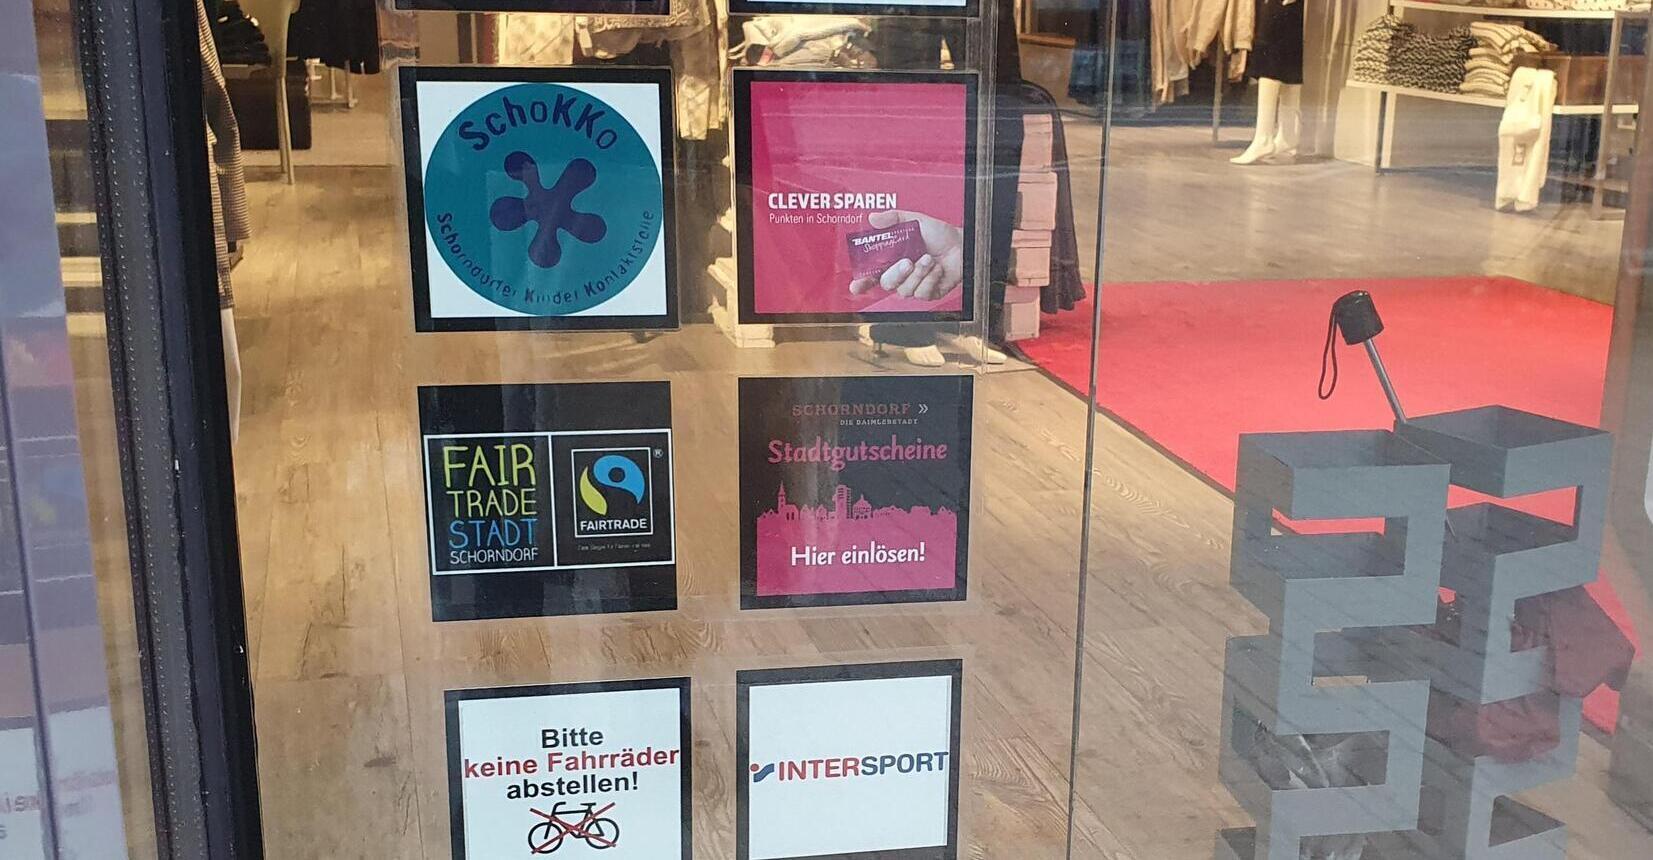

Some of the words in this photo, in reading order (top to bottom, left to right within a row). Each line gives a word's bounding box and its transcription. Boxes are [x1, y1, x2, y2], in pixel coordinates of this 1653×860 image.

[768, 192, 831, 210] CLEVER
[834, 192, 898, 210] SPAREN
[769, 213, 804, 224] Punkten
[806, 213, 814, 223] in
[816, 213, 863, 224] Schorndorf
[852, 232, 893, 246] BANTEL
[792, 403, 911, 417] SCHORNDORF
[840, 418, 854, 426] DIE
[856, 418, 918, 426] DAIMLERSTADT
[767, 434, 948, 472] Stadtgutscheine
[442, 443, 537, 488] FAIR
[446, 488, 538, 518] TRADE
[449, 518, 538, 549] STADT
[580, 518, 648, 532] FAIRTRADE
[450, 547, 539, 565] SCHORNDORF
[791, 546, 836, 566] Hier
[841, 541, 926, 565] einlösen!
[541, 727, 604, 749] Bitte
[464, 756, 538, 779] keine
[547, 746, 680, 773] Fahrräder
[778, 751, 950, 781] INTERSPORT
[506, 771, 639, 800] abstellen!
